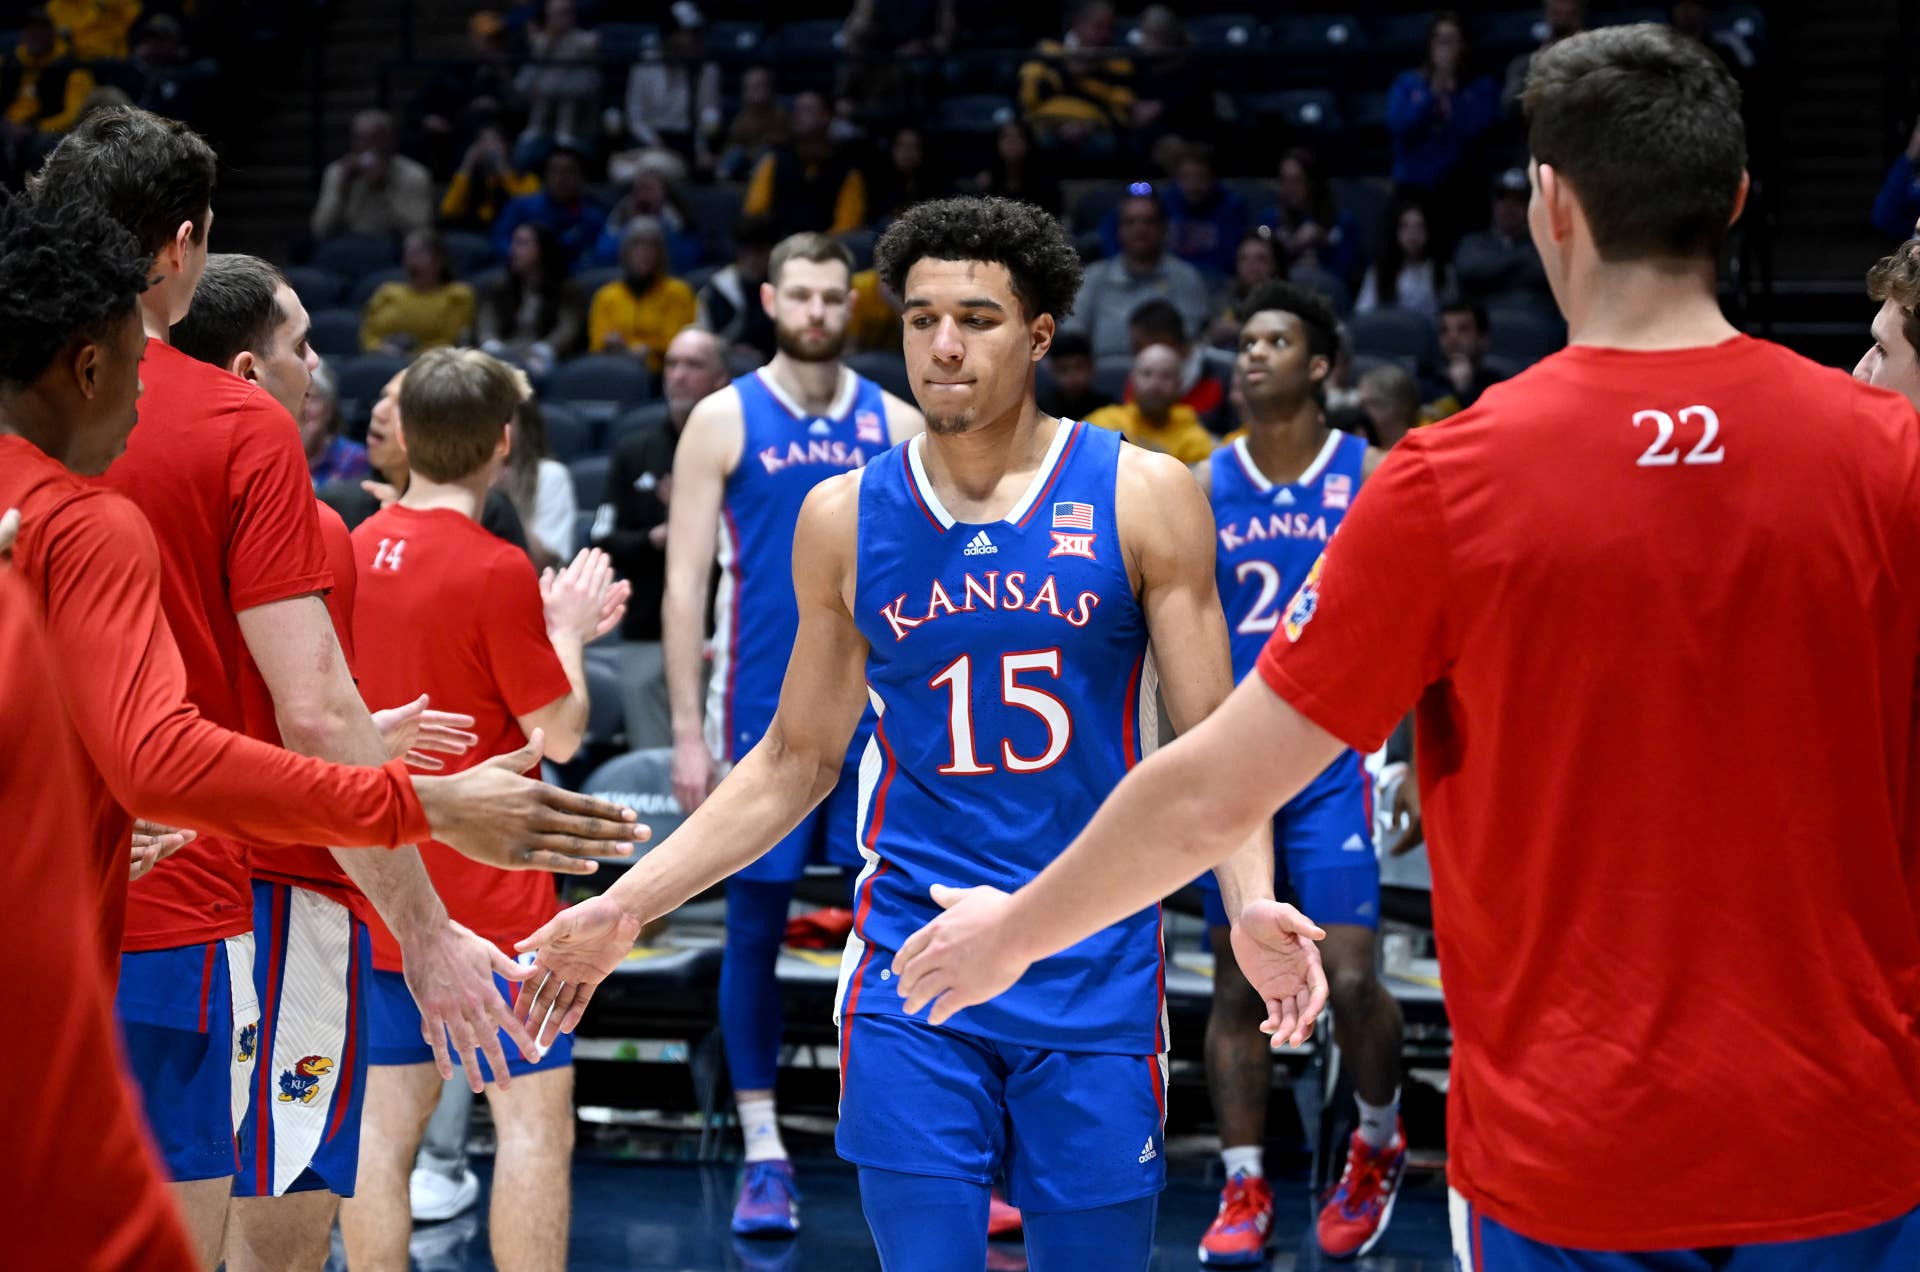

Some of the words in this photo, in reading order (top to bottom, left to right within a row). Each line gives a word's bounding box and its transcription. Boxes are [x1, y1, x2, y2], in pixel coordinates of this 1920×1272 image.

[1631, 404, 1726, 467] 22
[758, 440, 866, 476] KANSA
[1049, 531, 1097, 560] XII
[1219, 512, 1341, 551] KANSA
[372, 538, 406, 571] 14
[963, 545, 998, 556] adidas
[880, 572, 1099, 641] KANSAS
[930, 646, 1073, 774] 15
[291, 1080, 305, 1089] KU
